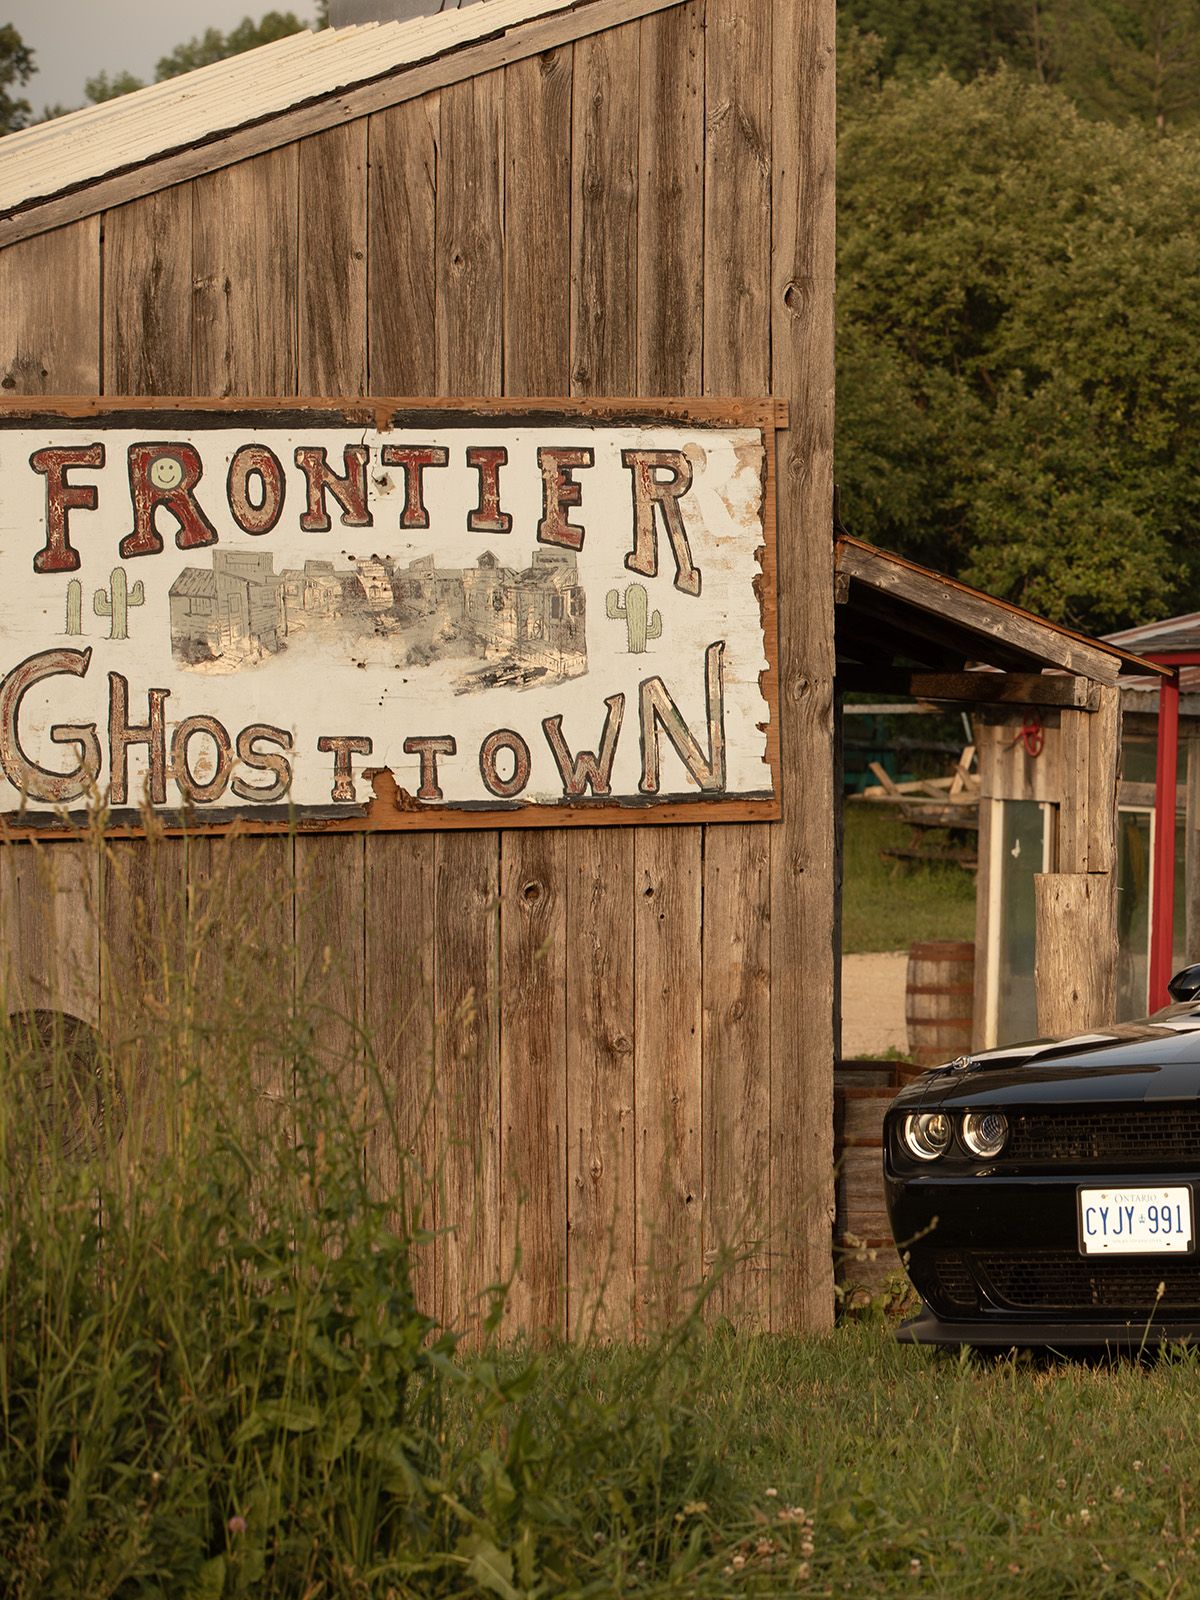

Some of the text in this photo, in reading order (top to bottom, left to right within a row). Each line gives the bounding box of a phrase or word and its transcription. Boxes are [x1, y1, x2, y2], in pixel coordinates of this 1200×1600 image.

[29, 442, 702, 597] FRONTIER
[0, 640, 726, 804] GHOST TOWN
[1086, 1205, 1183, 1235] CYJY 991
